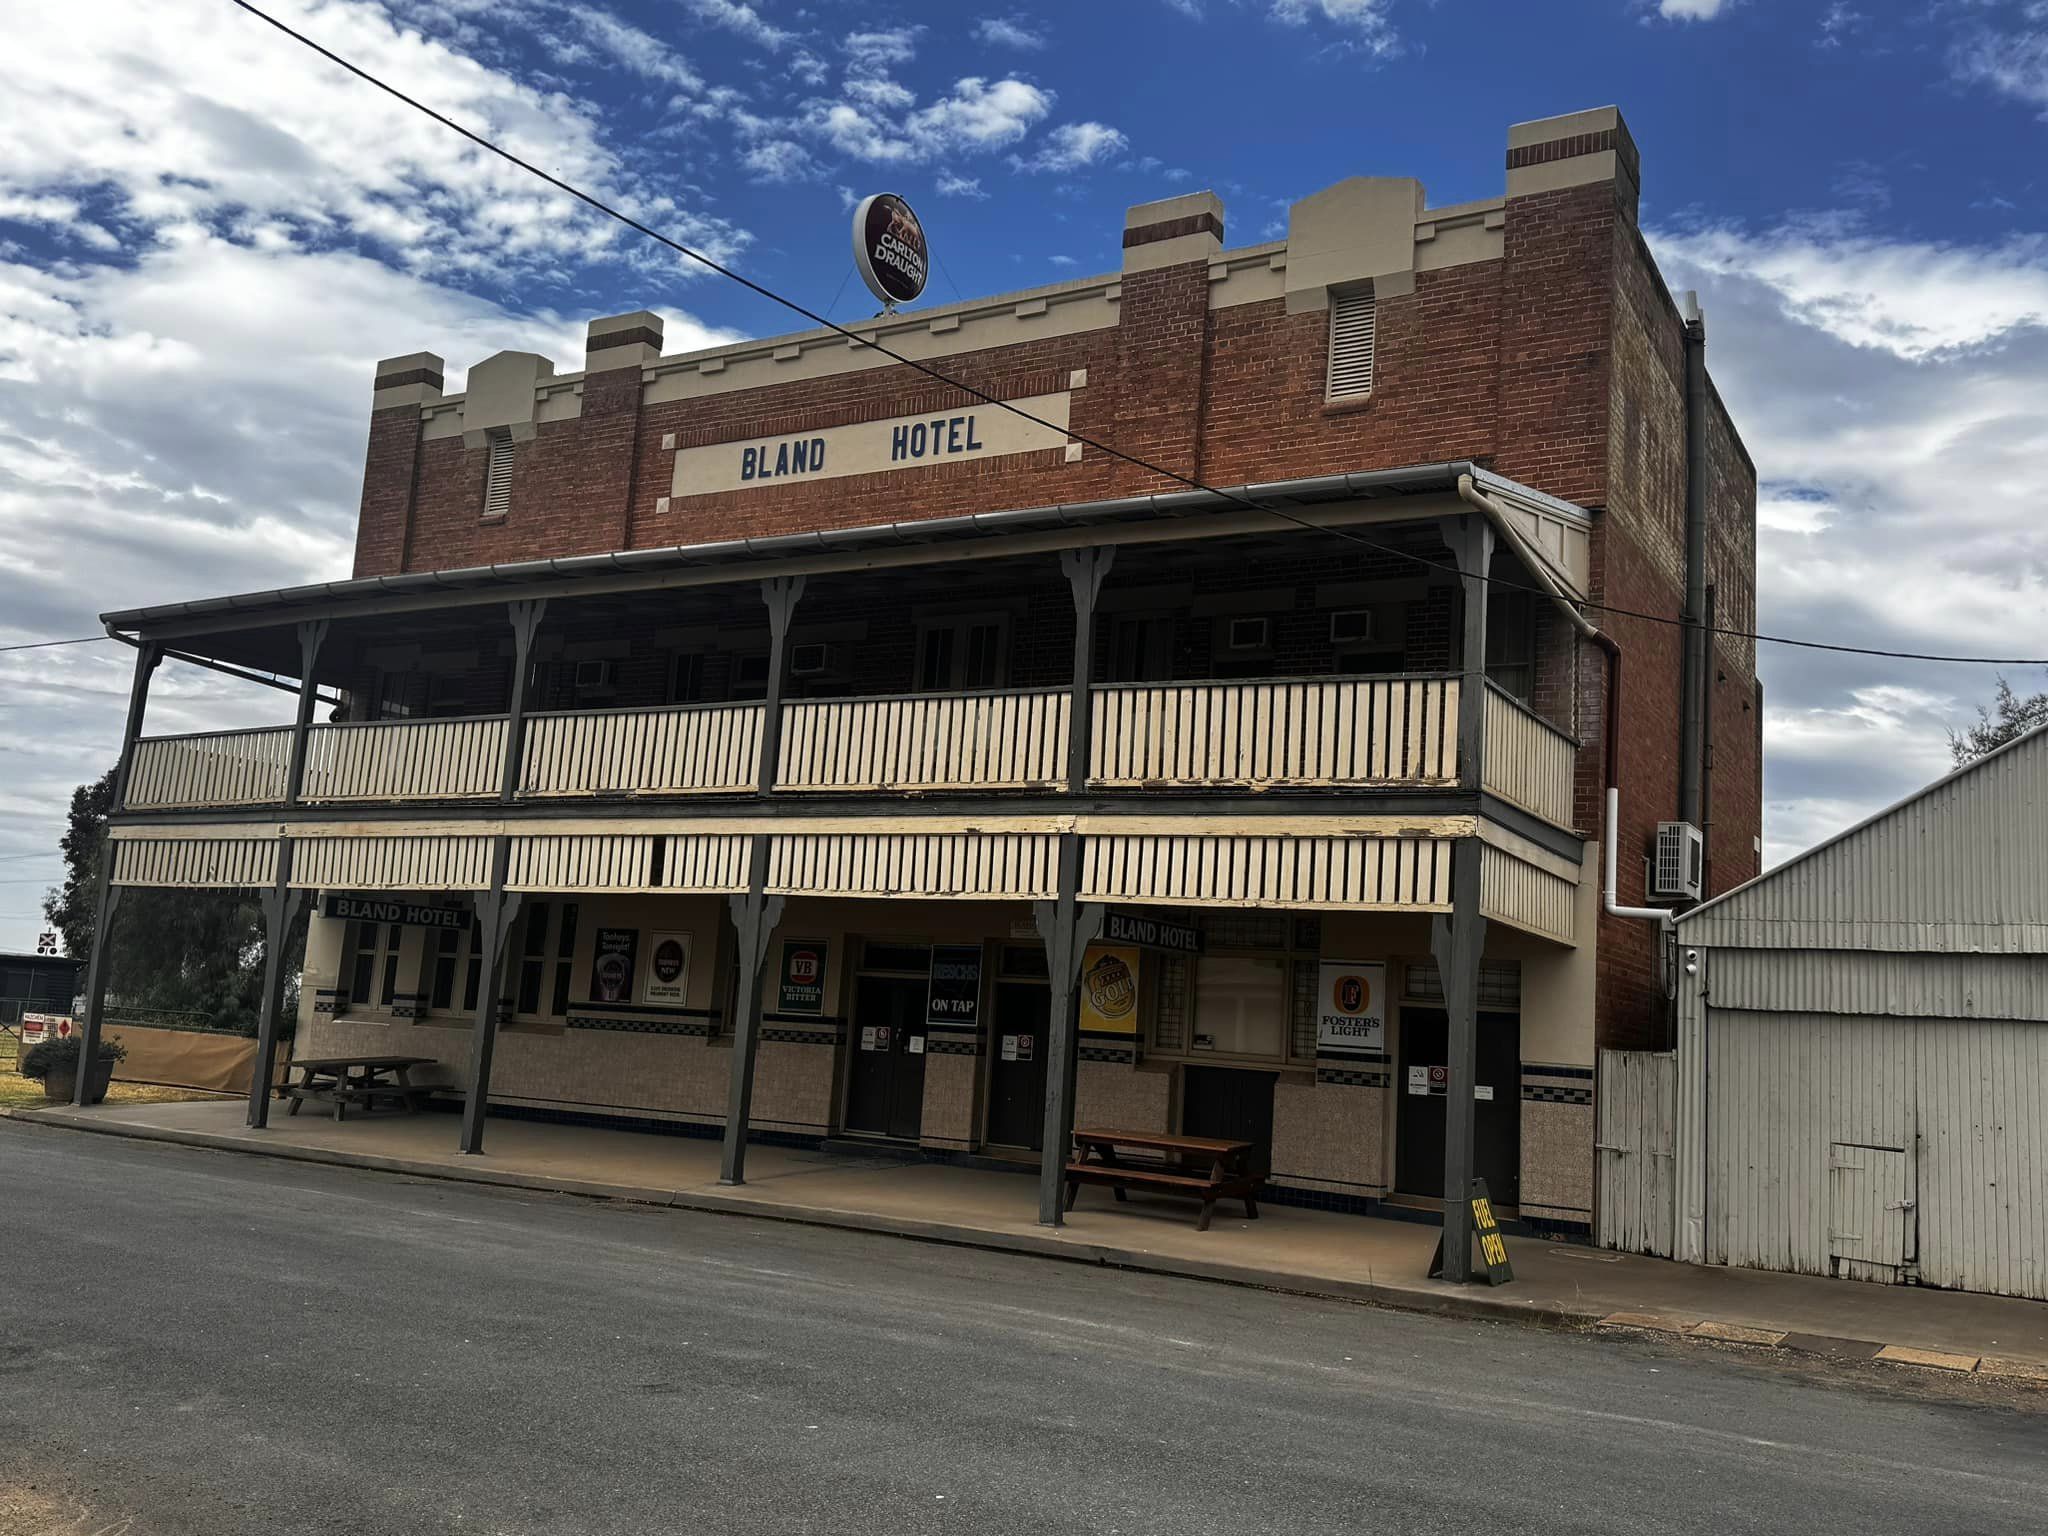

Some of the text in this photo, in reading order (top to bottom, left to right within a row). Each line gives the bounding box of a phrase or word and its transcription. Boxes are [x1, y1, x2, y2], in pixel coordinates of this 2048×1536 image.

[874, 244, 922, 285] DRAUGHT
[881, 233, 923, 271] CARLTON
[741, 415, 982, 481] BLAND HOTEL
[336, 899, 461, 927] BLAND HOTEL
[1110, 916, 1199, 951] BLAND HOTEL
[795, 960, 812, 974] VB
[782, 985, 822, 994] VICTORIA
[786, 993, 816, 1001] BITTER
[932, 998, 975, 1013] ON TAP
[1322, 1015, 1380, 1028] FOSTER'S
[1331, 1025, 1370, 1037] LIGHT
[1472, 1198, 1496, 1230] FUEL
[1482, 1232, 1508, 1266] OPEN
